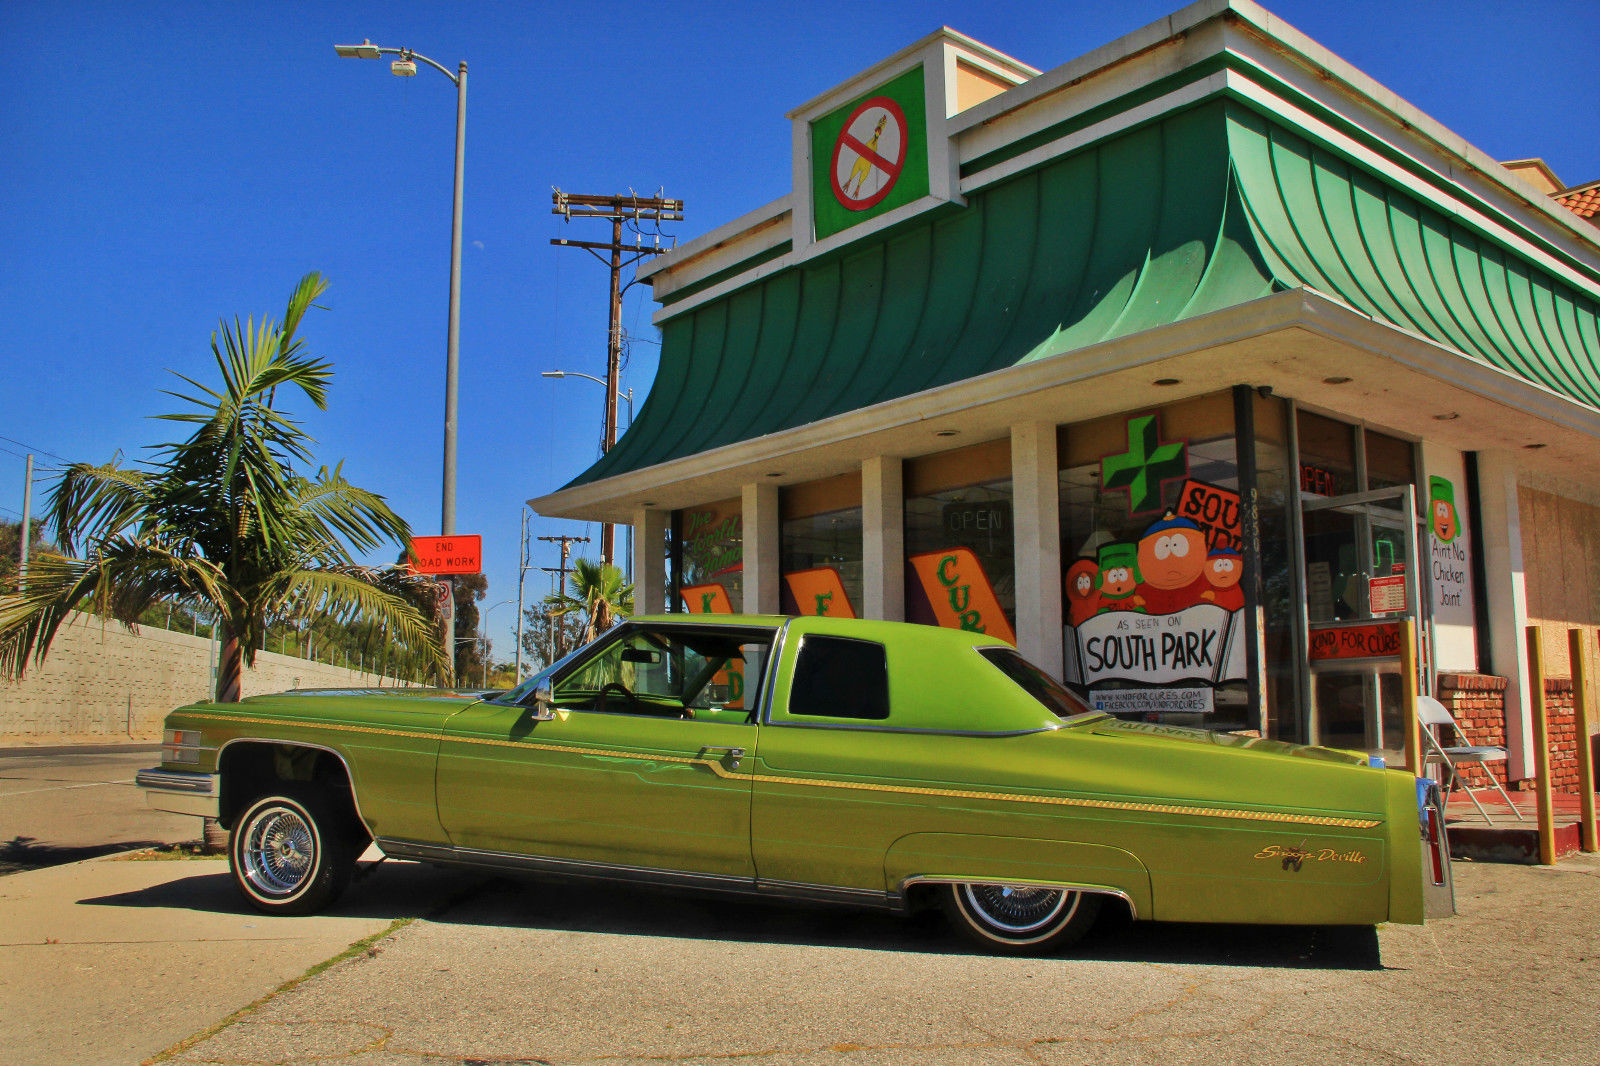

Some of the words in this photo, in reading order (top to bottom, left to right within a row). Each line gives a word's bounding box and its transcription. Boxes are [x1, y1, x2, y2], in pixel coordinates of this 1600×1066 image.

[951, 510, 1001, 530] OPEN
[436, 542, 453, 552] END
[1452, 541, 1465, 561] No
[420, 558, 442, 568] OAD
[446, 557, 475, 567] WORK
[1432, 560, 1465, 584] Chicken
[1117, 620, 1129, 630] AS
[1135, 618, 1159, 629] SEEN
[1167, 616, 1181, 627] ON
[1086, 634, 1157, 672] SOUTH
[1161, 628, 1217, 670] PARK
[1341, 631, 1367, 651] FOR
[1317, 848, 1367, 864] Deville
